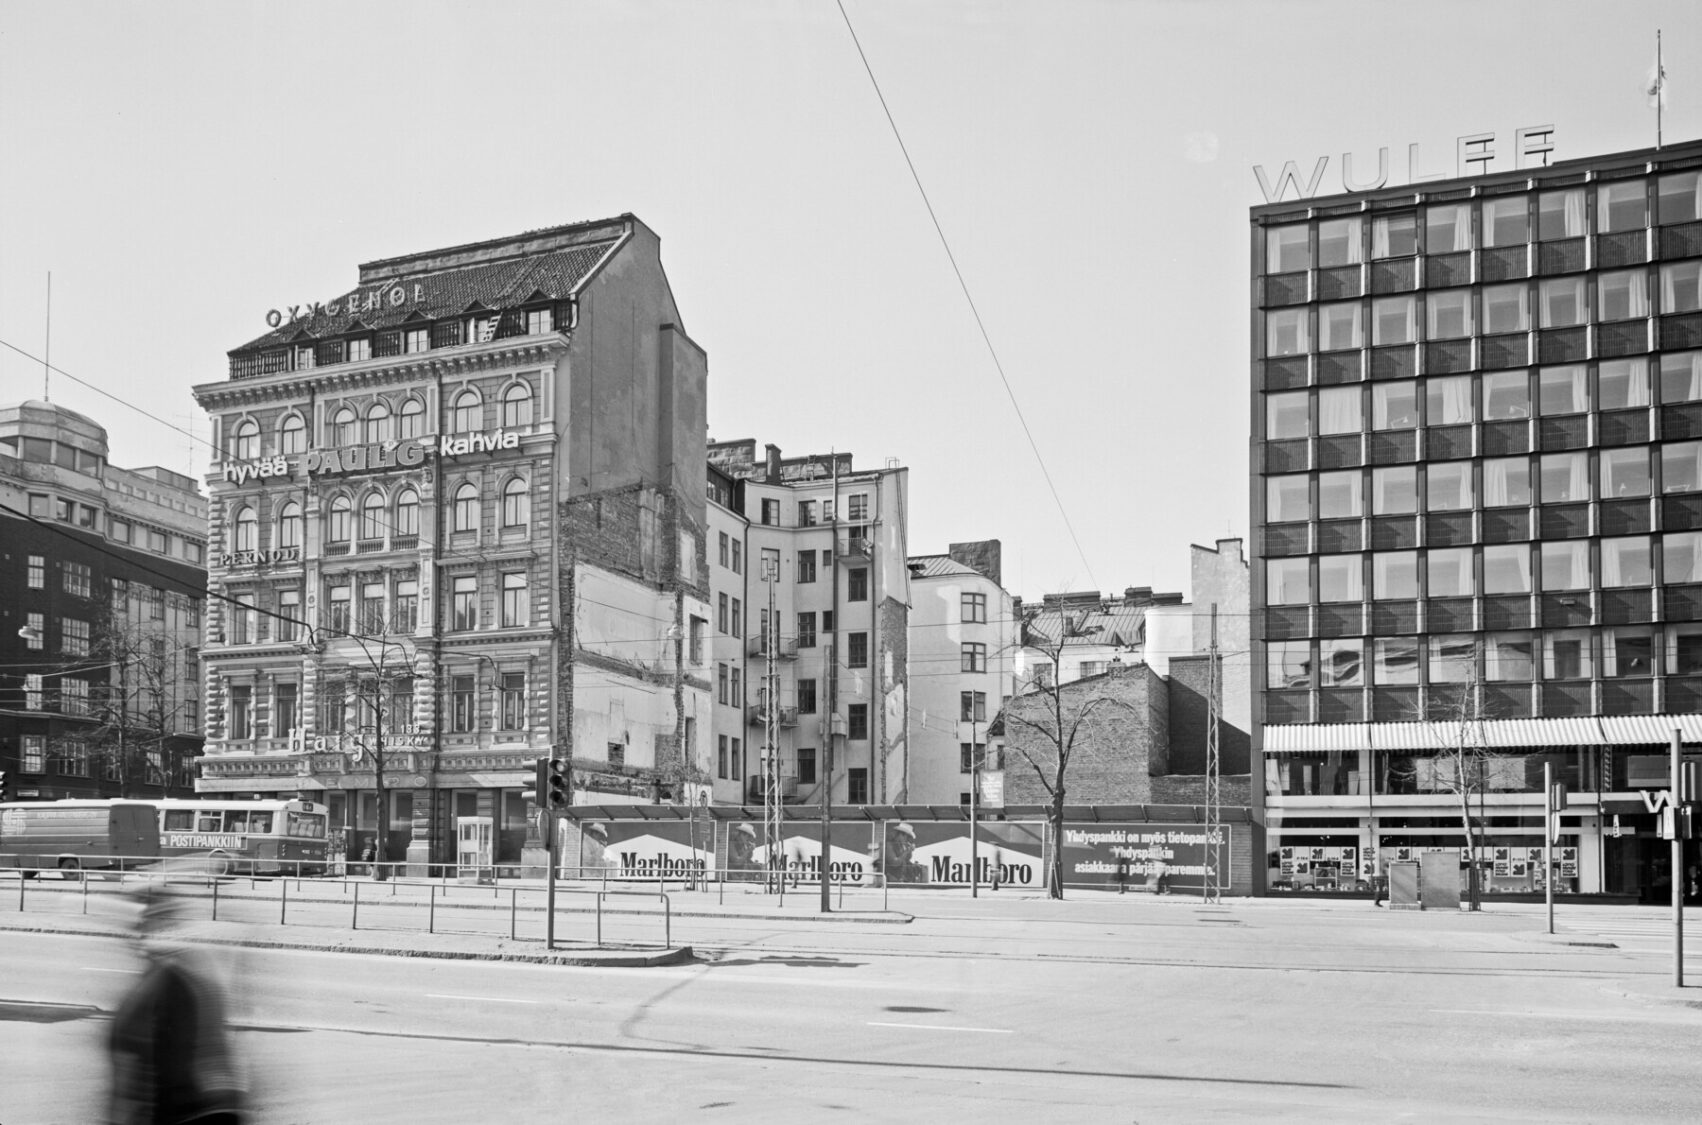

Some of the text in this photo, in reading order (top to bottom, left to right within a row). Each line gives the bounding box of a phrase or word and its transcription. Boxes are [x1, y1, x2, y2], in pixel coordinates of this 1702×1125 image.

[1252, 124, 1555, 204] WULFF
[223, 428, 519, 485] hyvää PAULIG kahvia
[220, 549, 296, 566] PERNOD
[288, 728, 363, 762] Haig
[170, 835, 242, 849] POSTIPANKKIIN
[1066, 830, 1126, 845] Yhdyspankki
[1127, 834, 1140, 843] on
[1141, 832, 1166, 846] myös
[620, 852, 705, 878] Marlboro
